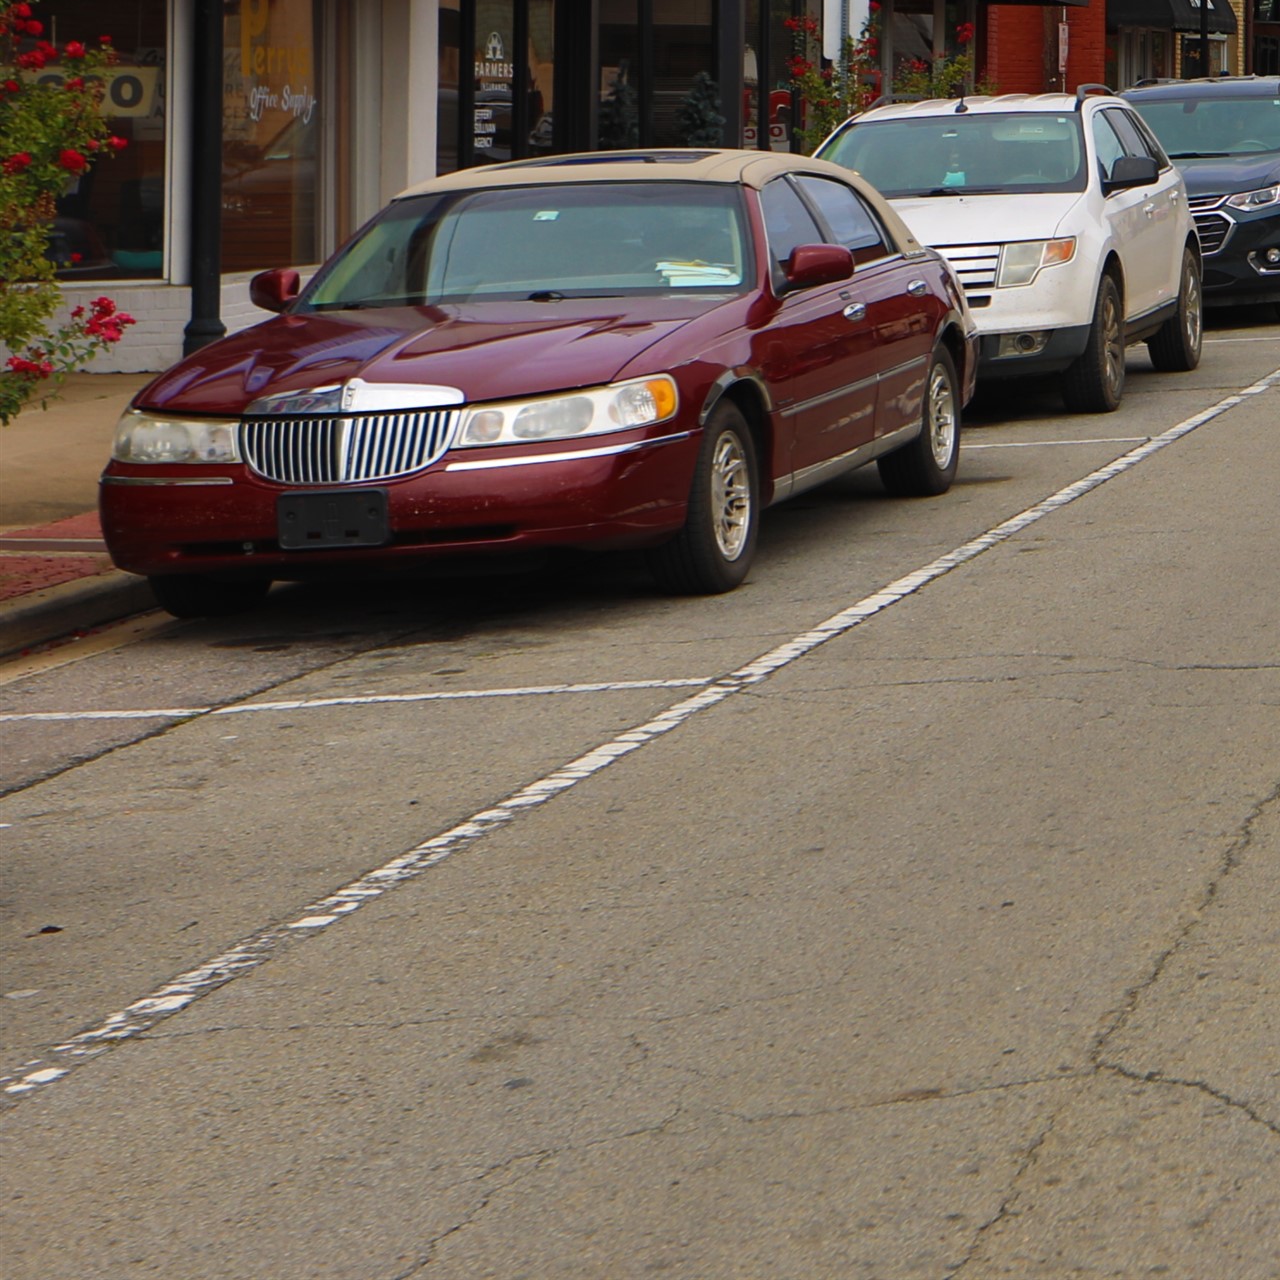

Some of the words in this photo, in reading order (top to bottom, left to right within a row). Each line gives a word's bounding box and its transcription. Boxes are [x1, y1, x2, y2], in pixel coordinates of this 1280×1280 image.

[474, 62, 513, 78] FARMERS
[250, 85, 279, 122] Office
[281, 84, 317, 124] Supply
